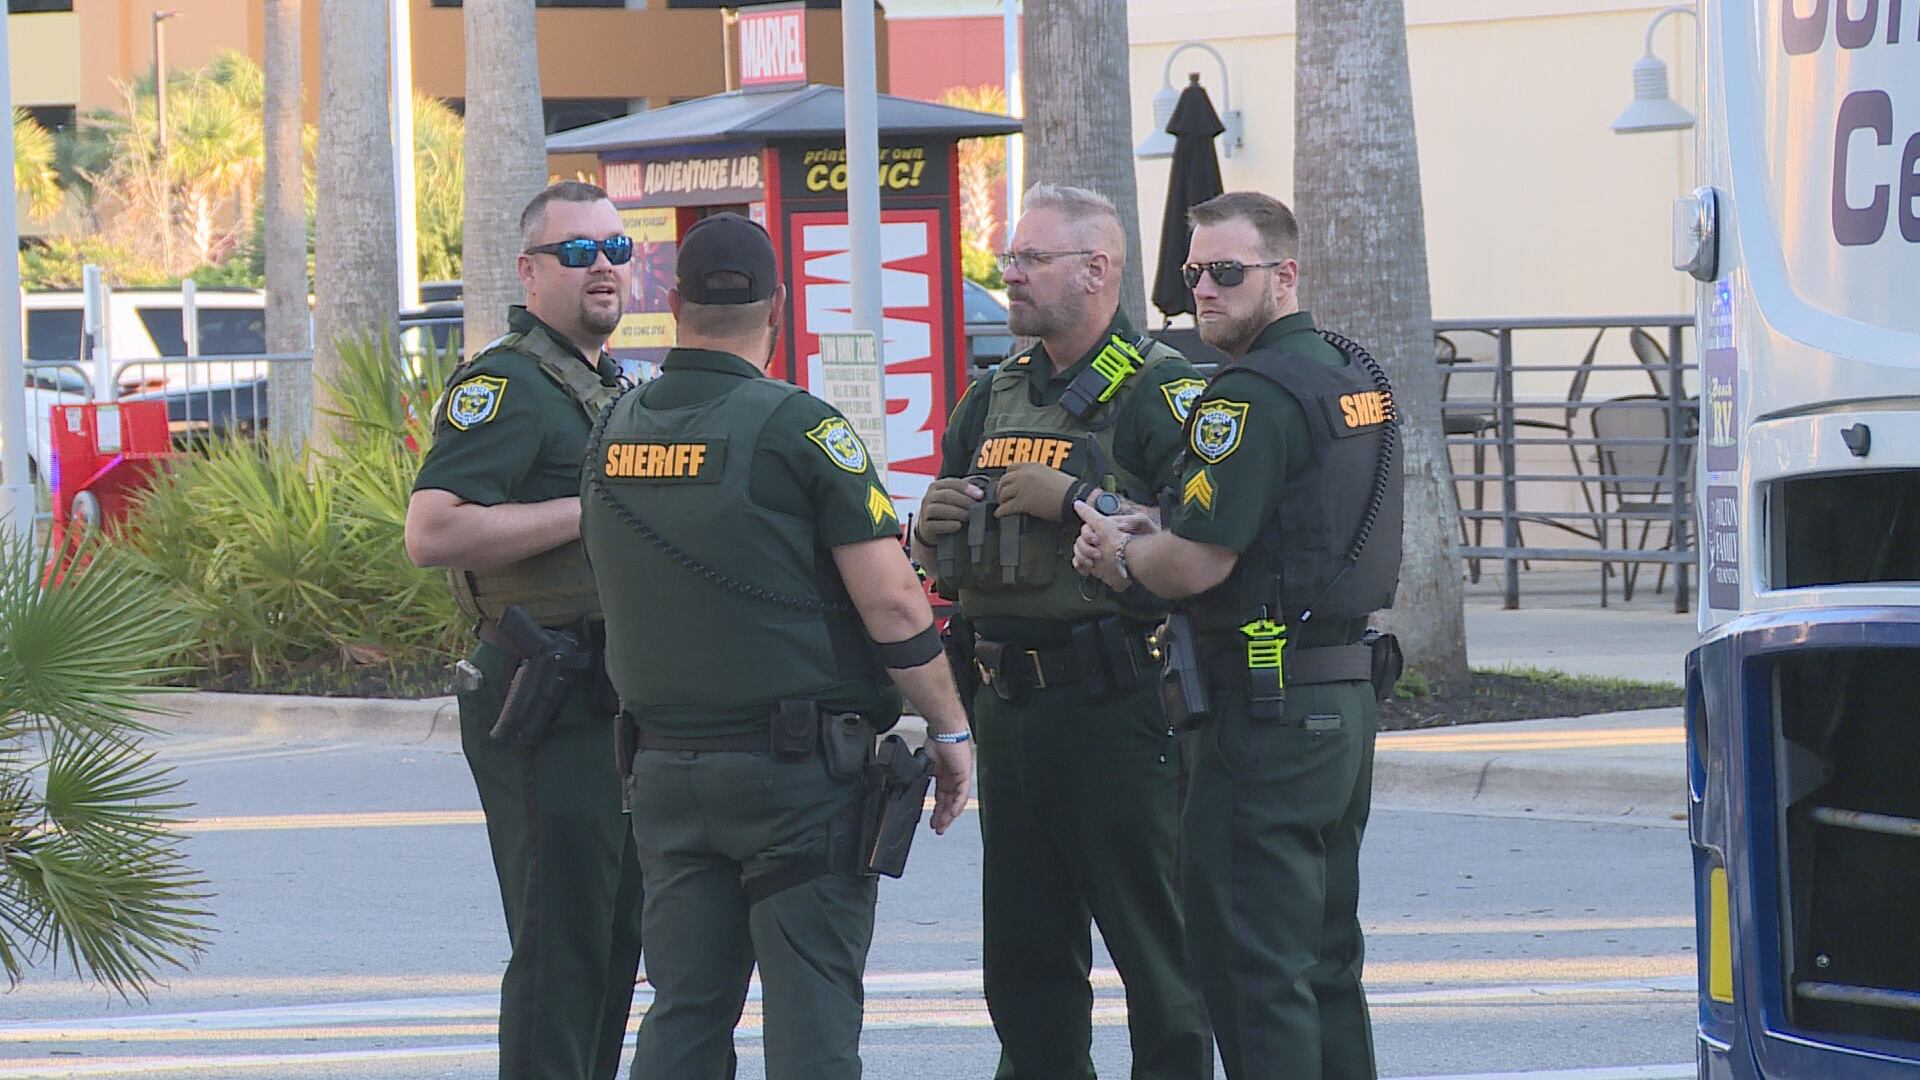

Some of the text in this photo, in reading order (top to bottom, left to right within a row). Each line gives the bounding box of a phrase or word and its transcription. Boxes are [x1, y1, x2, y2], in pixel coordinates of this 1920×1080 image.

[741, 14, 803, 78] MARVEL
[892, 147, 924, 160] own
[606, 163, 641, 198] MARVEL
[644, 158, 728, 194] ADVENTURE
[806, 159, 926, 192] COIC!
[1713, 400, 1733, 446] RV
[605, 443, 707, 477] SHERIFF
[977, 437, 1073, 469] SHERIFF
[1716, 531, 1737, 562] FAMILY
